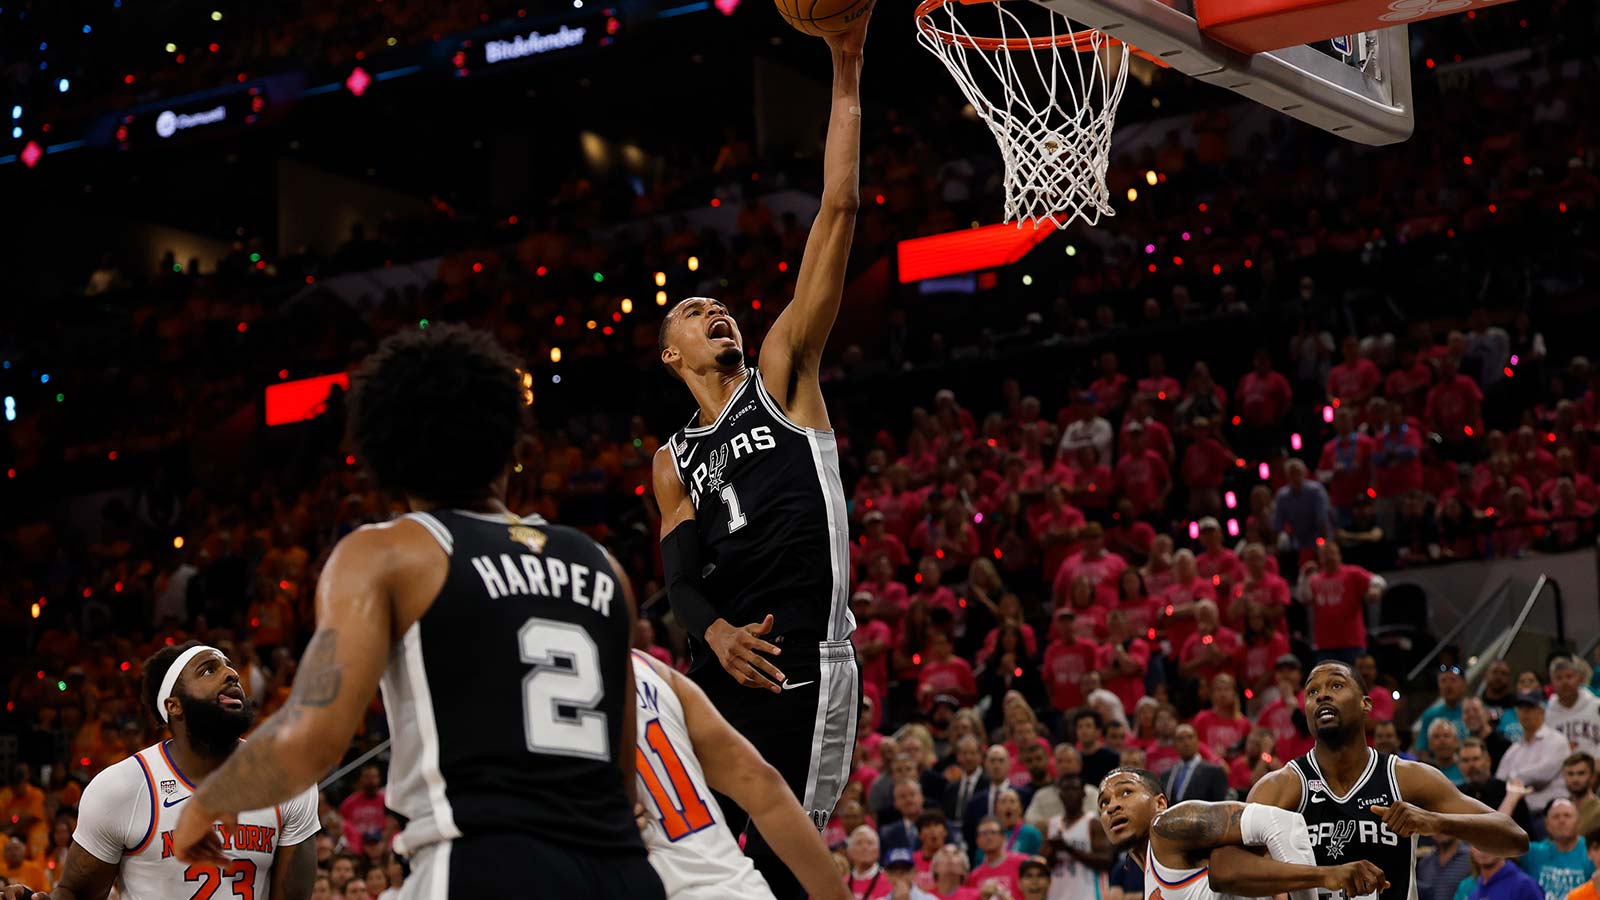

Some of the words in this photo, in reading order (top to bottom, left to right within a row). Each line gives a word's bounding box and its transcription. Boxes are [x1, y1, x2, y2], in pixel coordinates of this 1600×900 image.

[485, 25, 586, 63] Bitdefender
[731, 402, 754, 423] LEDGER
[719, 483, 747, 533] 1
[471, 553, 615, 617] HARPER
[517, 616, 611, 762] 2
[636, 718, 716, 843] 11
[1360, 796, 1385, 807] LEDGER
[218, 824, 276, 854] YORK
[184, 859, 257, 900] 23
